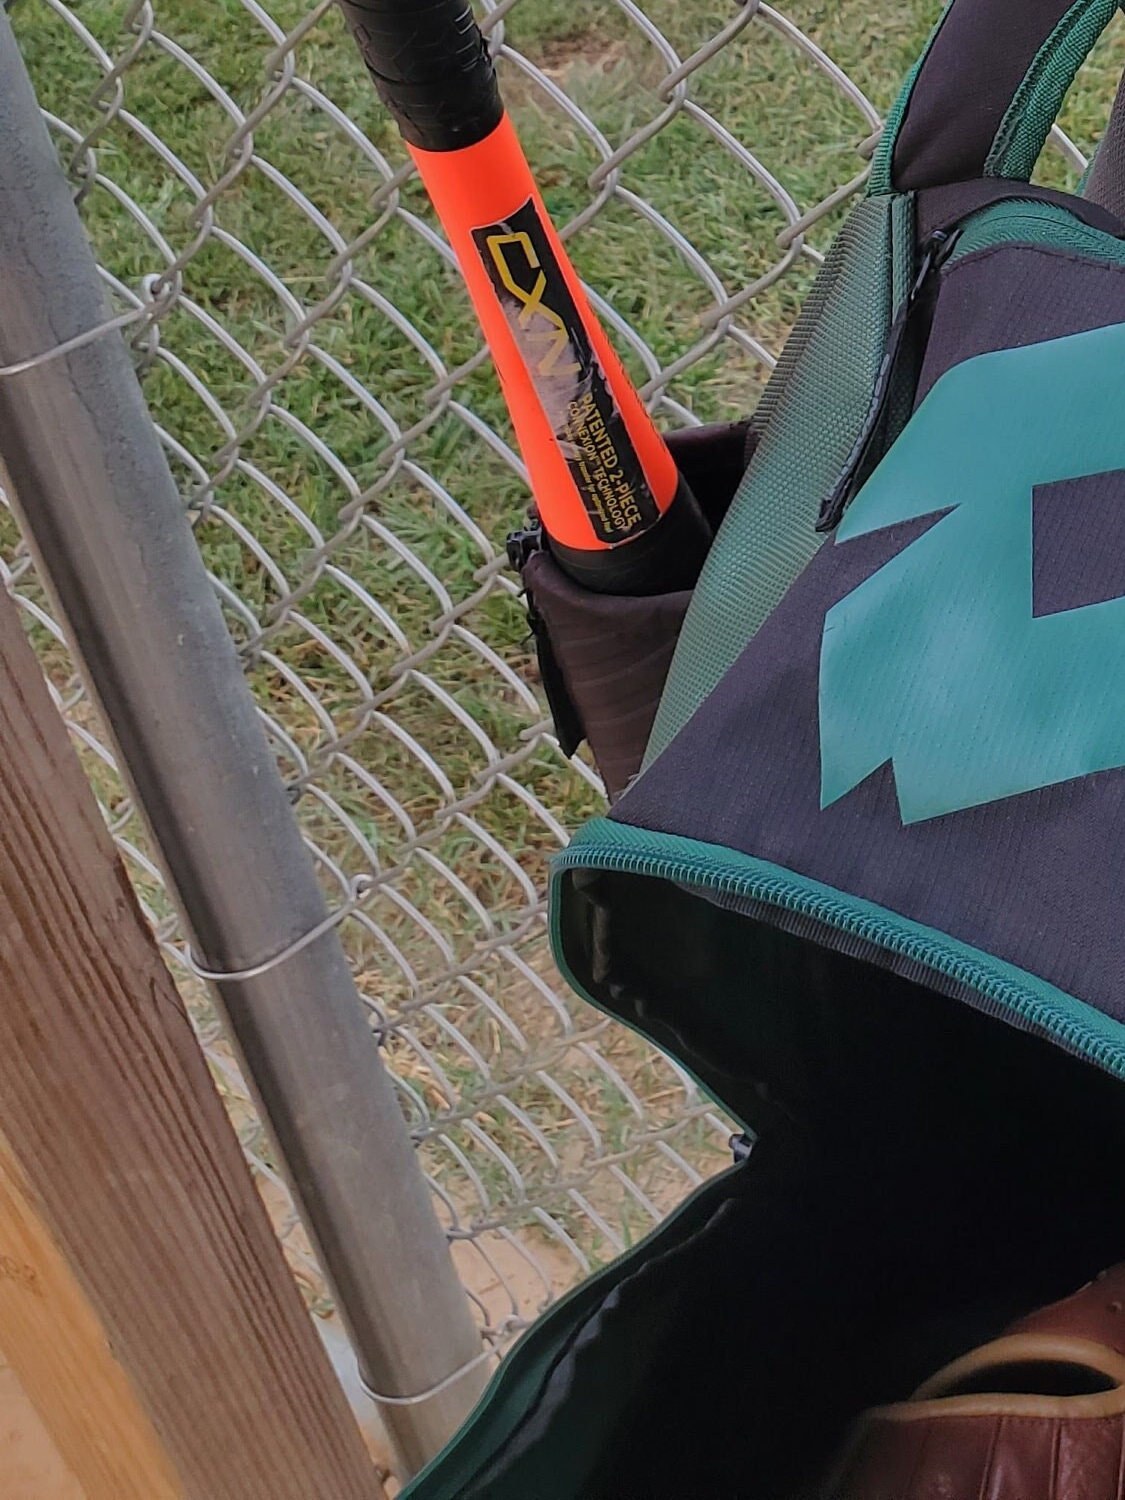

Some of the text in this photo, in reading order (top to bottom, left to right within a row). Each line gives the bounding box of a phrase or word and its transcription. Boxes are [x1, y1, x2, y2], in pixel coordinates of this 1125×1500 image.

[576, 391, 643, 527] PATENTED 2-PIECE
[593, 465, 627, 529] TECHNOLOGY
